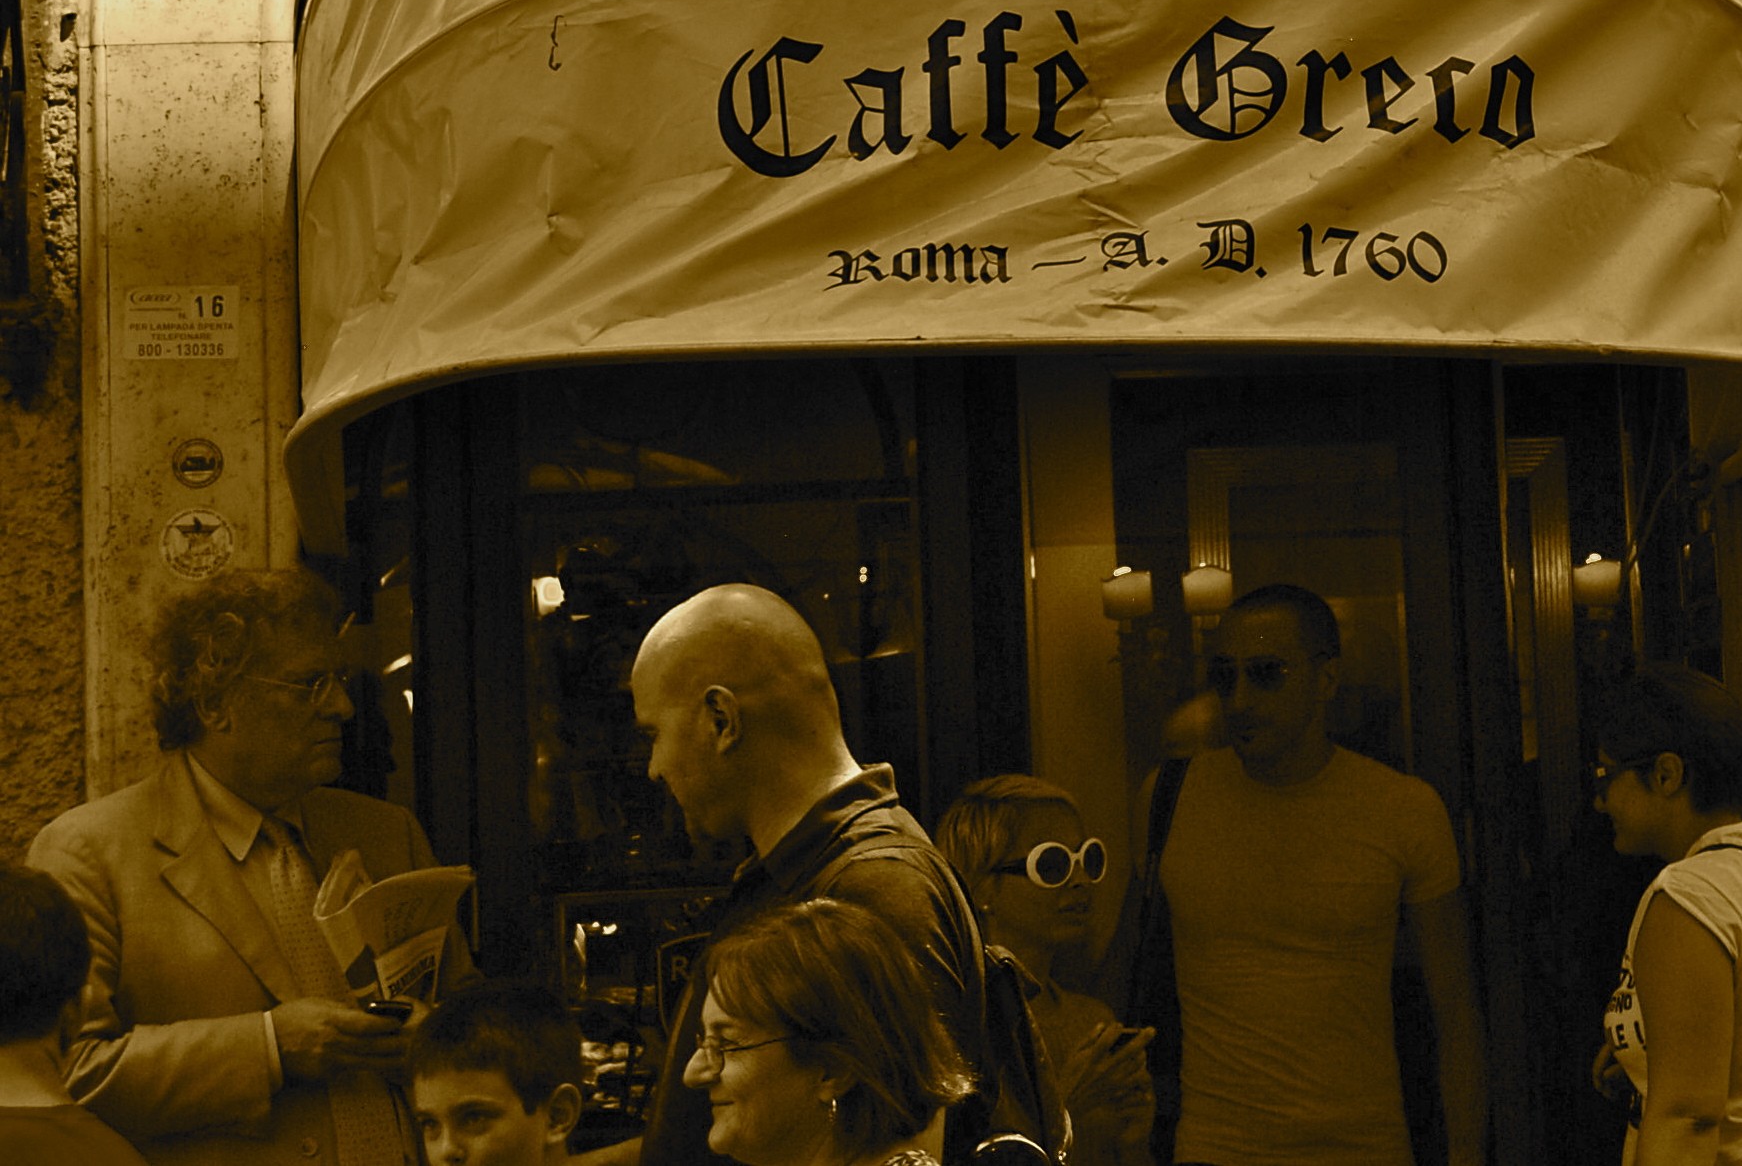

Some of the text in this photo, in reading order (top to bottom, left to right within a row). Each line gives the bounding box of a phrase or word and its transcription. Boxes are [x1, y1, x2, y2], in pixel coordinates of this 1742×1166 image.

[717, 9, 1537, 178] Caffè Greco
[825, 241, 1011, 292] Roma
[1301, 222, 1449, 285] 1760
[150, 322, 195, 331] LAMPADA
[194, 294, 225, 318] 16
